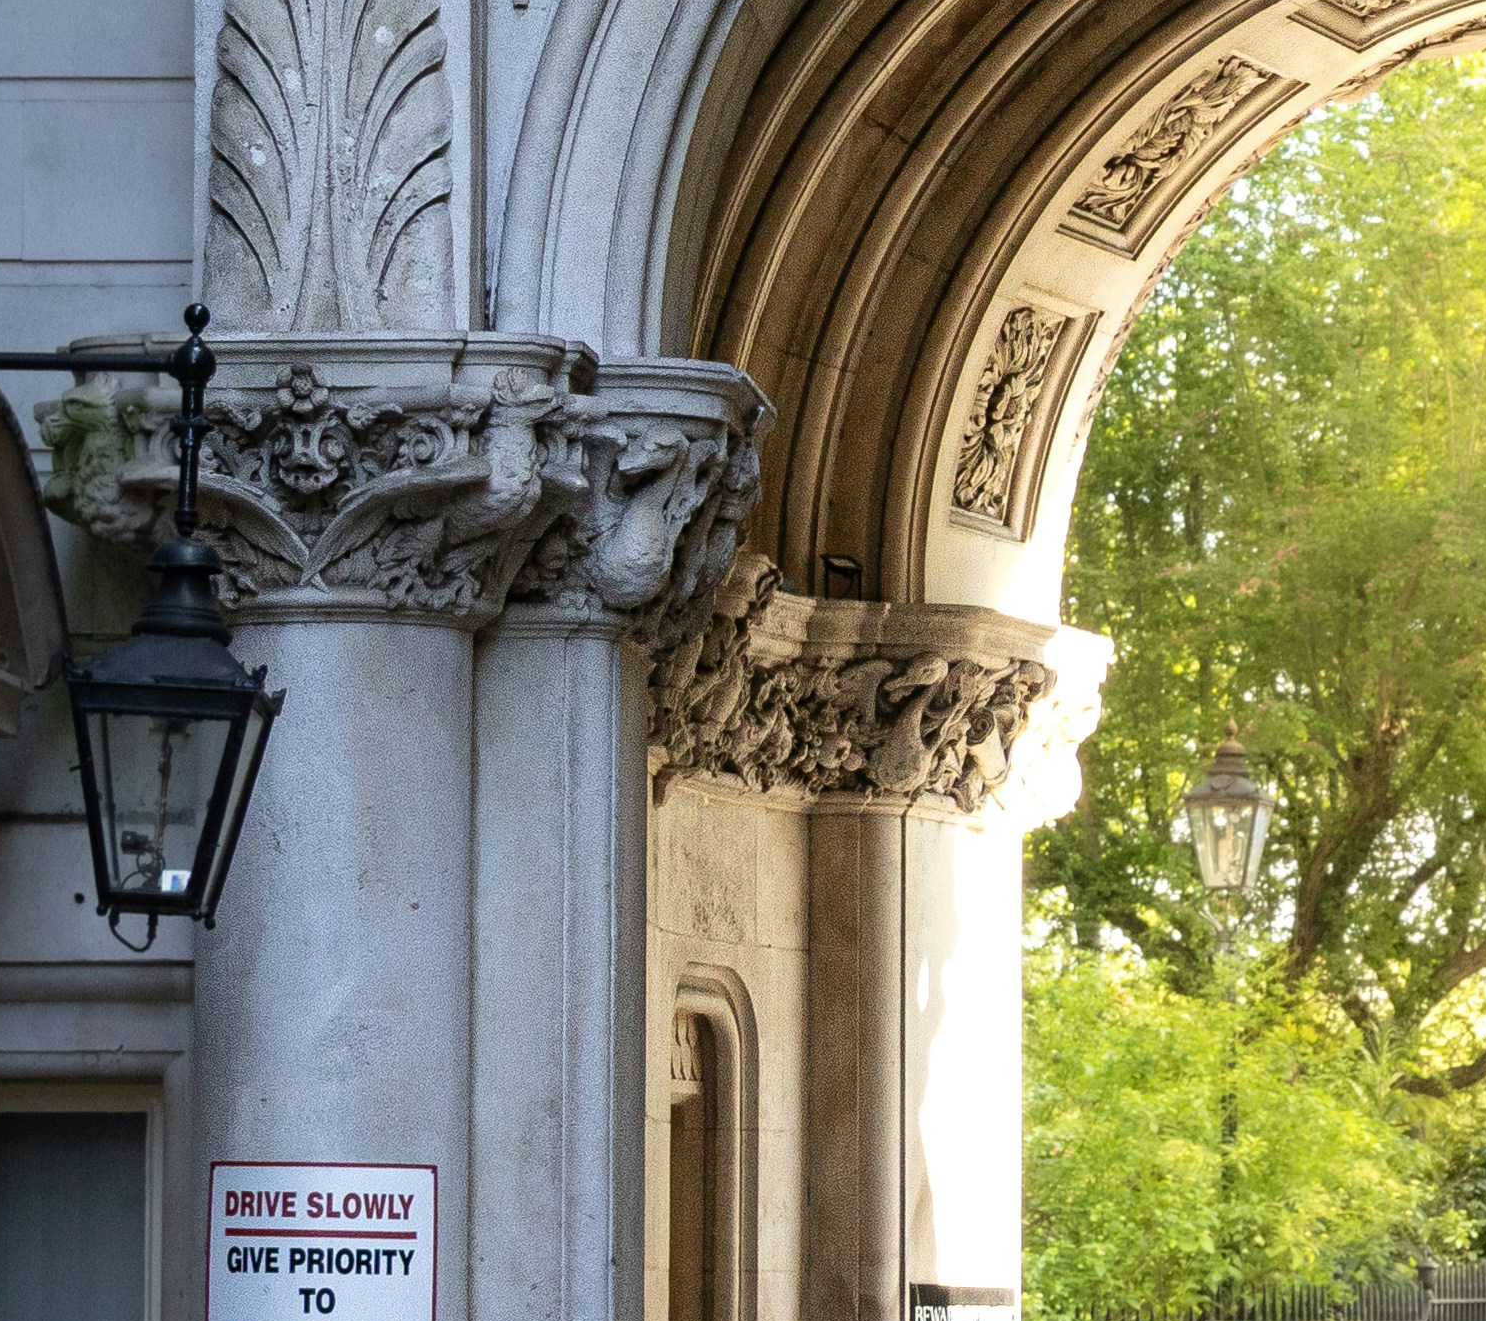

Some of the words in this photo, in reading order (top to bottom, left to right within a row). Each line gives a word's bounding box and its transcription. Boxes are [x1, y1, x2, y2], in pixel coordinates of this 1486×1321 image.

[225, 1190, 297, 1217] DRIVE
[306, 1191, 414, 1220] SLOWLY
[227, 1246, 279, 1273] GIVE
[289, 1247, 415, 1276] PRIORITY
[299, 1287, 336, 1314] TO
